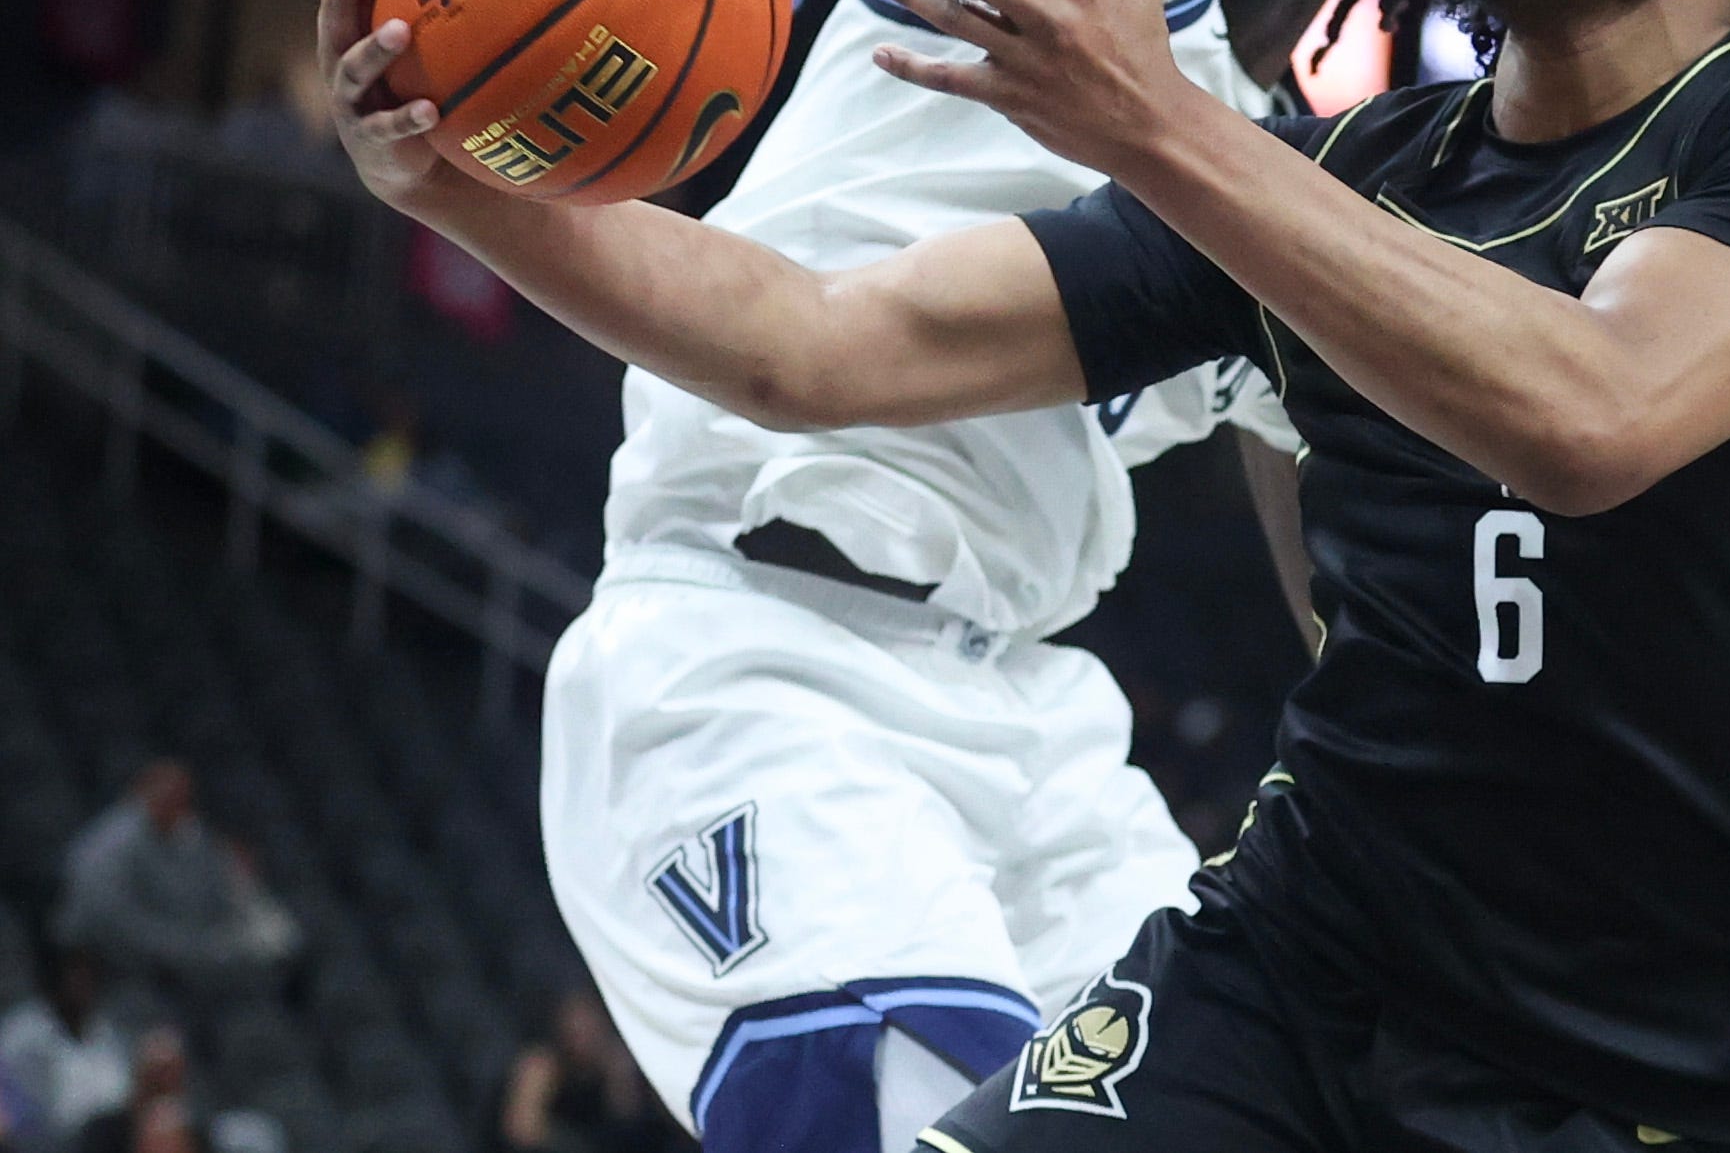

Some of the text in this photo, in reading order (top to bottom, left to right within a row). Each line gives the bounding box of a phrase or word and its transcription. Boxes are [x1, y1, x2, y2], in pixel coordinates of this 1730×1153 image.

[462, 23, 610, 151] CHAMNSHIP
[471, 35, 658, 185] ELITE
[1473, 509, 1545, 684] 6
[646, 801, 768, 978] V
